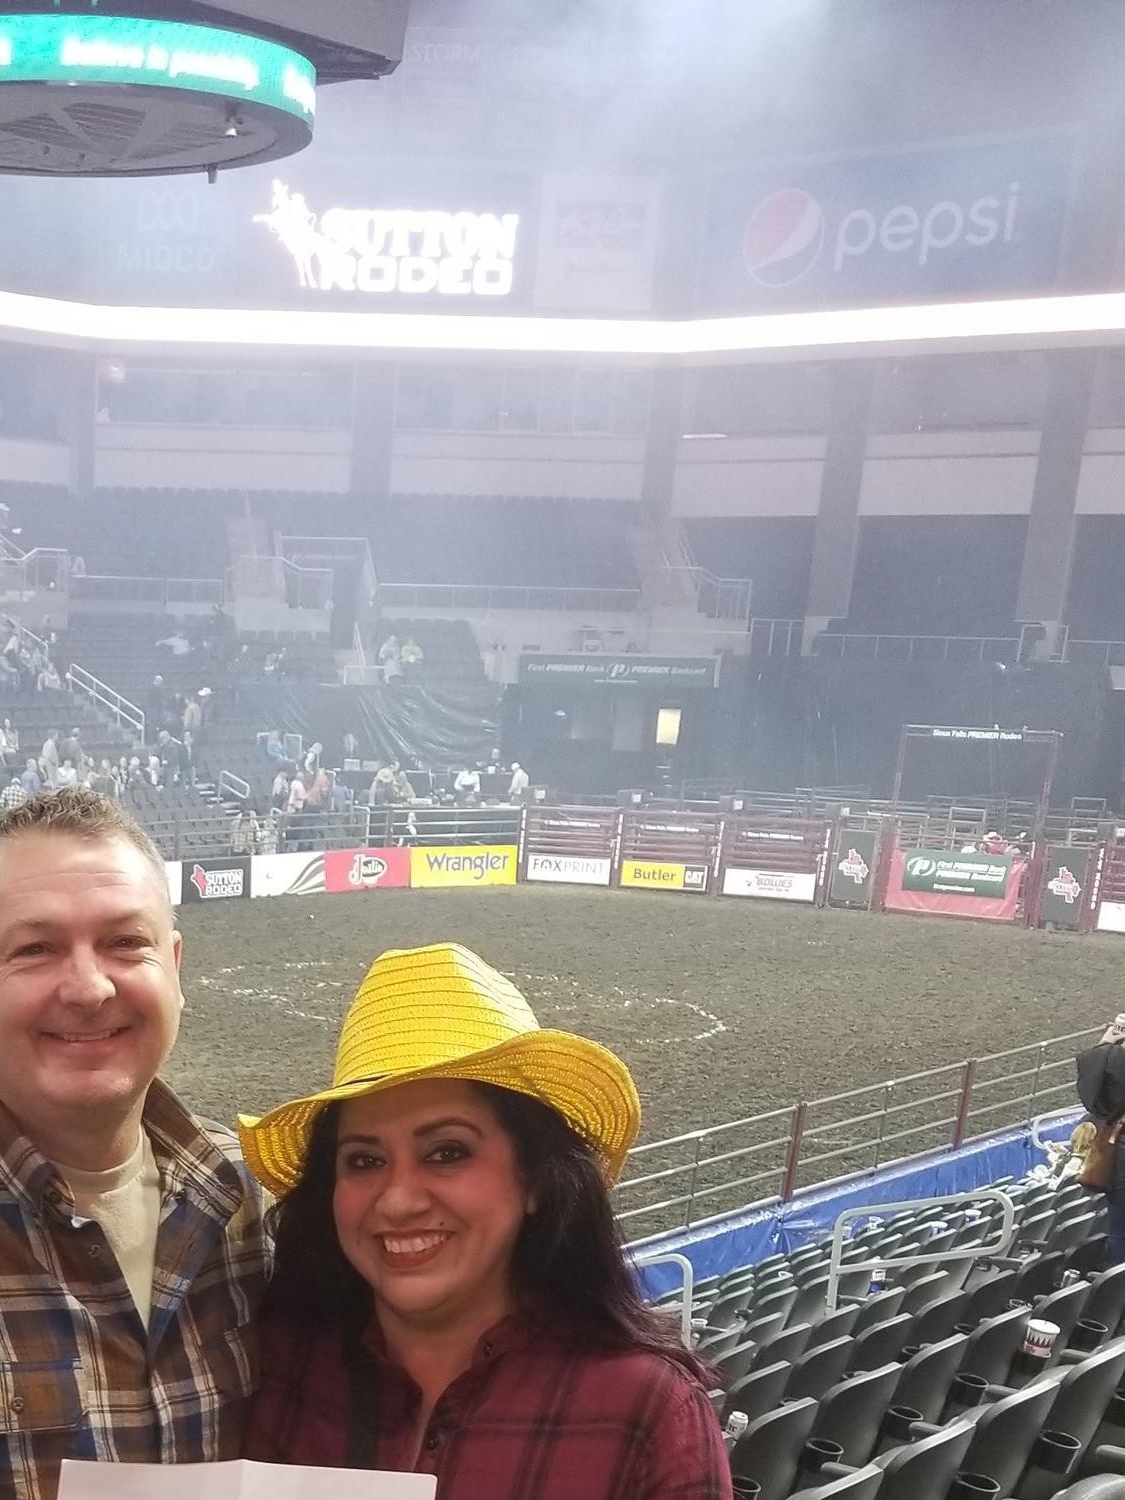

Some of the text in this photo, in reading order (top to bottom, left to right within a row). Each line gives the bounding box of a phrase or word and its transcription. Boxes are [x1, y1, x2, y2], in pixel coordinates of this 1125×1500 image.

[320, 207, 519, 257] SUTTON
[832, 182, 1022, 272] pepsi
[322, 255, 515, 295] RODEO
[426, 852, 510, 880] Wrangler
[634, 867, 678, 882] Butler
[684, 869, 705, 884] CAT
[206, 870, 244, 886] SUTTON
[206, 884, 244, 897] RODEO
